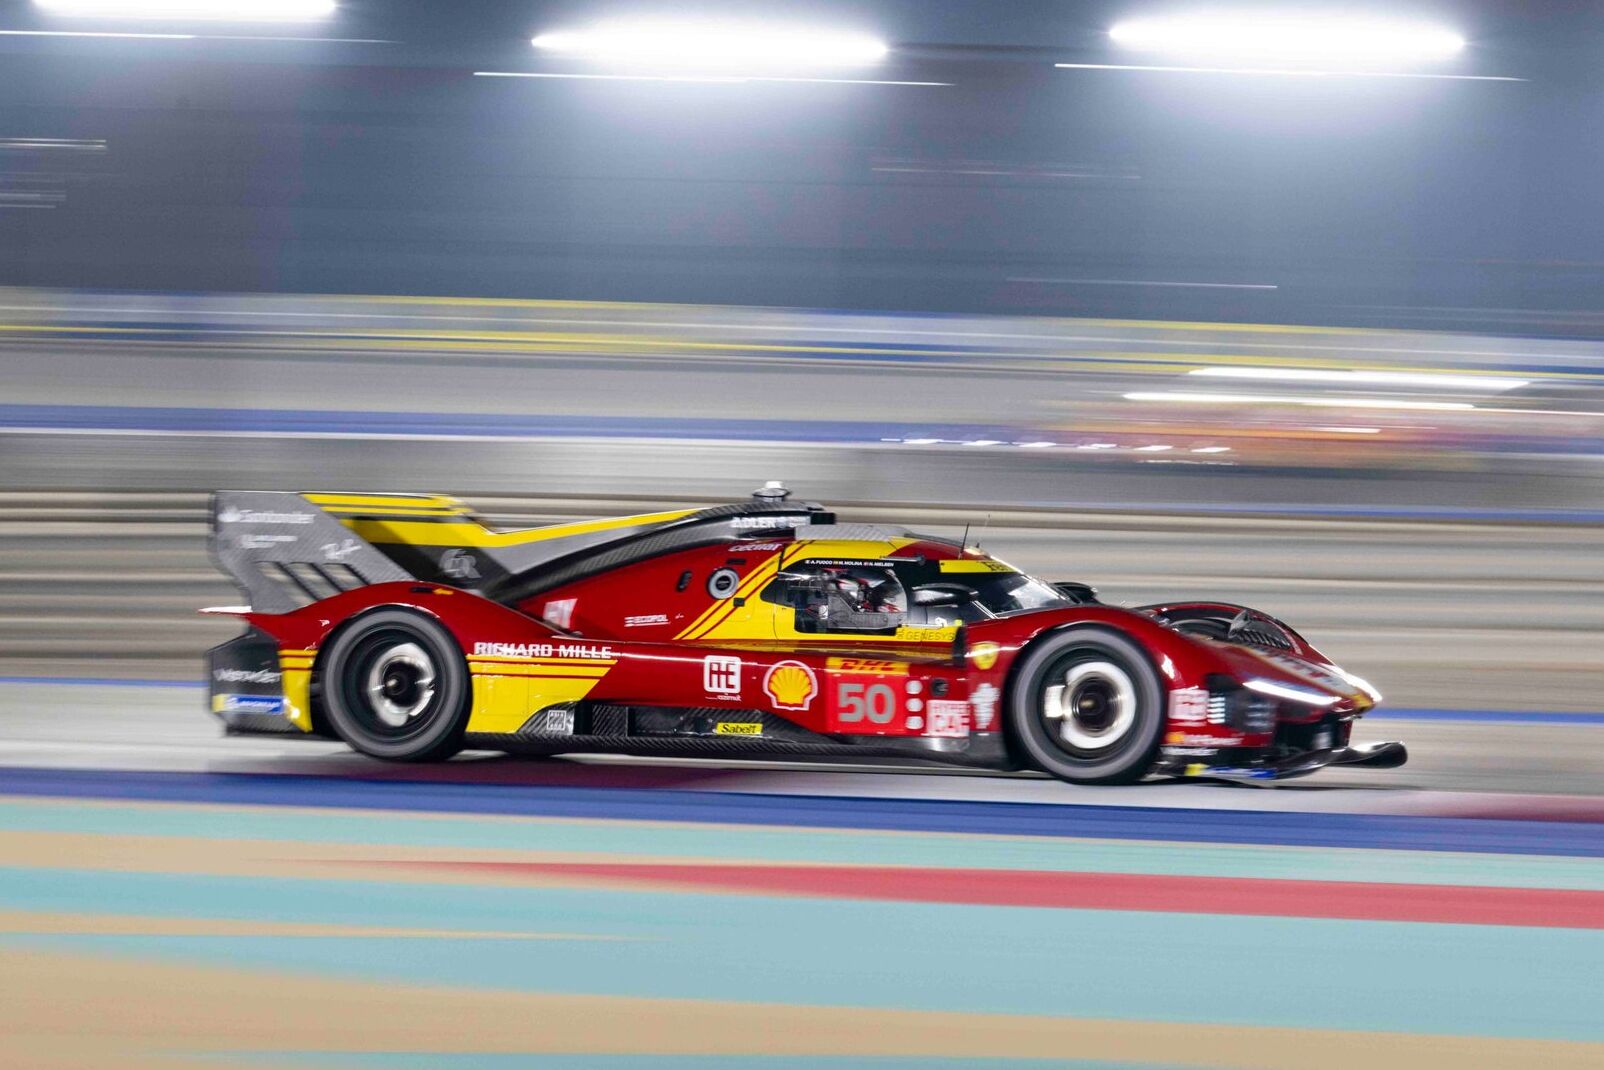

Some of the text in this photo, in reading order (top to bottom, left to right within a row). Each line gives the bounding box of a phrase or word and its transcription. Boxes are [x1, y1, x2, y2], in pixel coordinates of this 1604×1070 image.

[474, 641, 612, 659] RICHARD MILLE
[840, 659, 894, 672] DHL
[838, 682, 896, 724] 50
